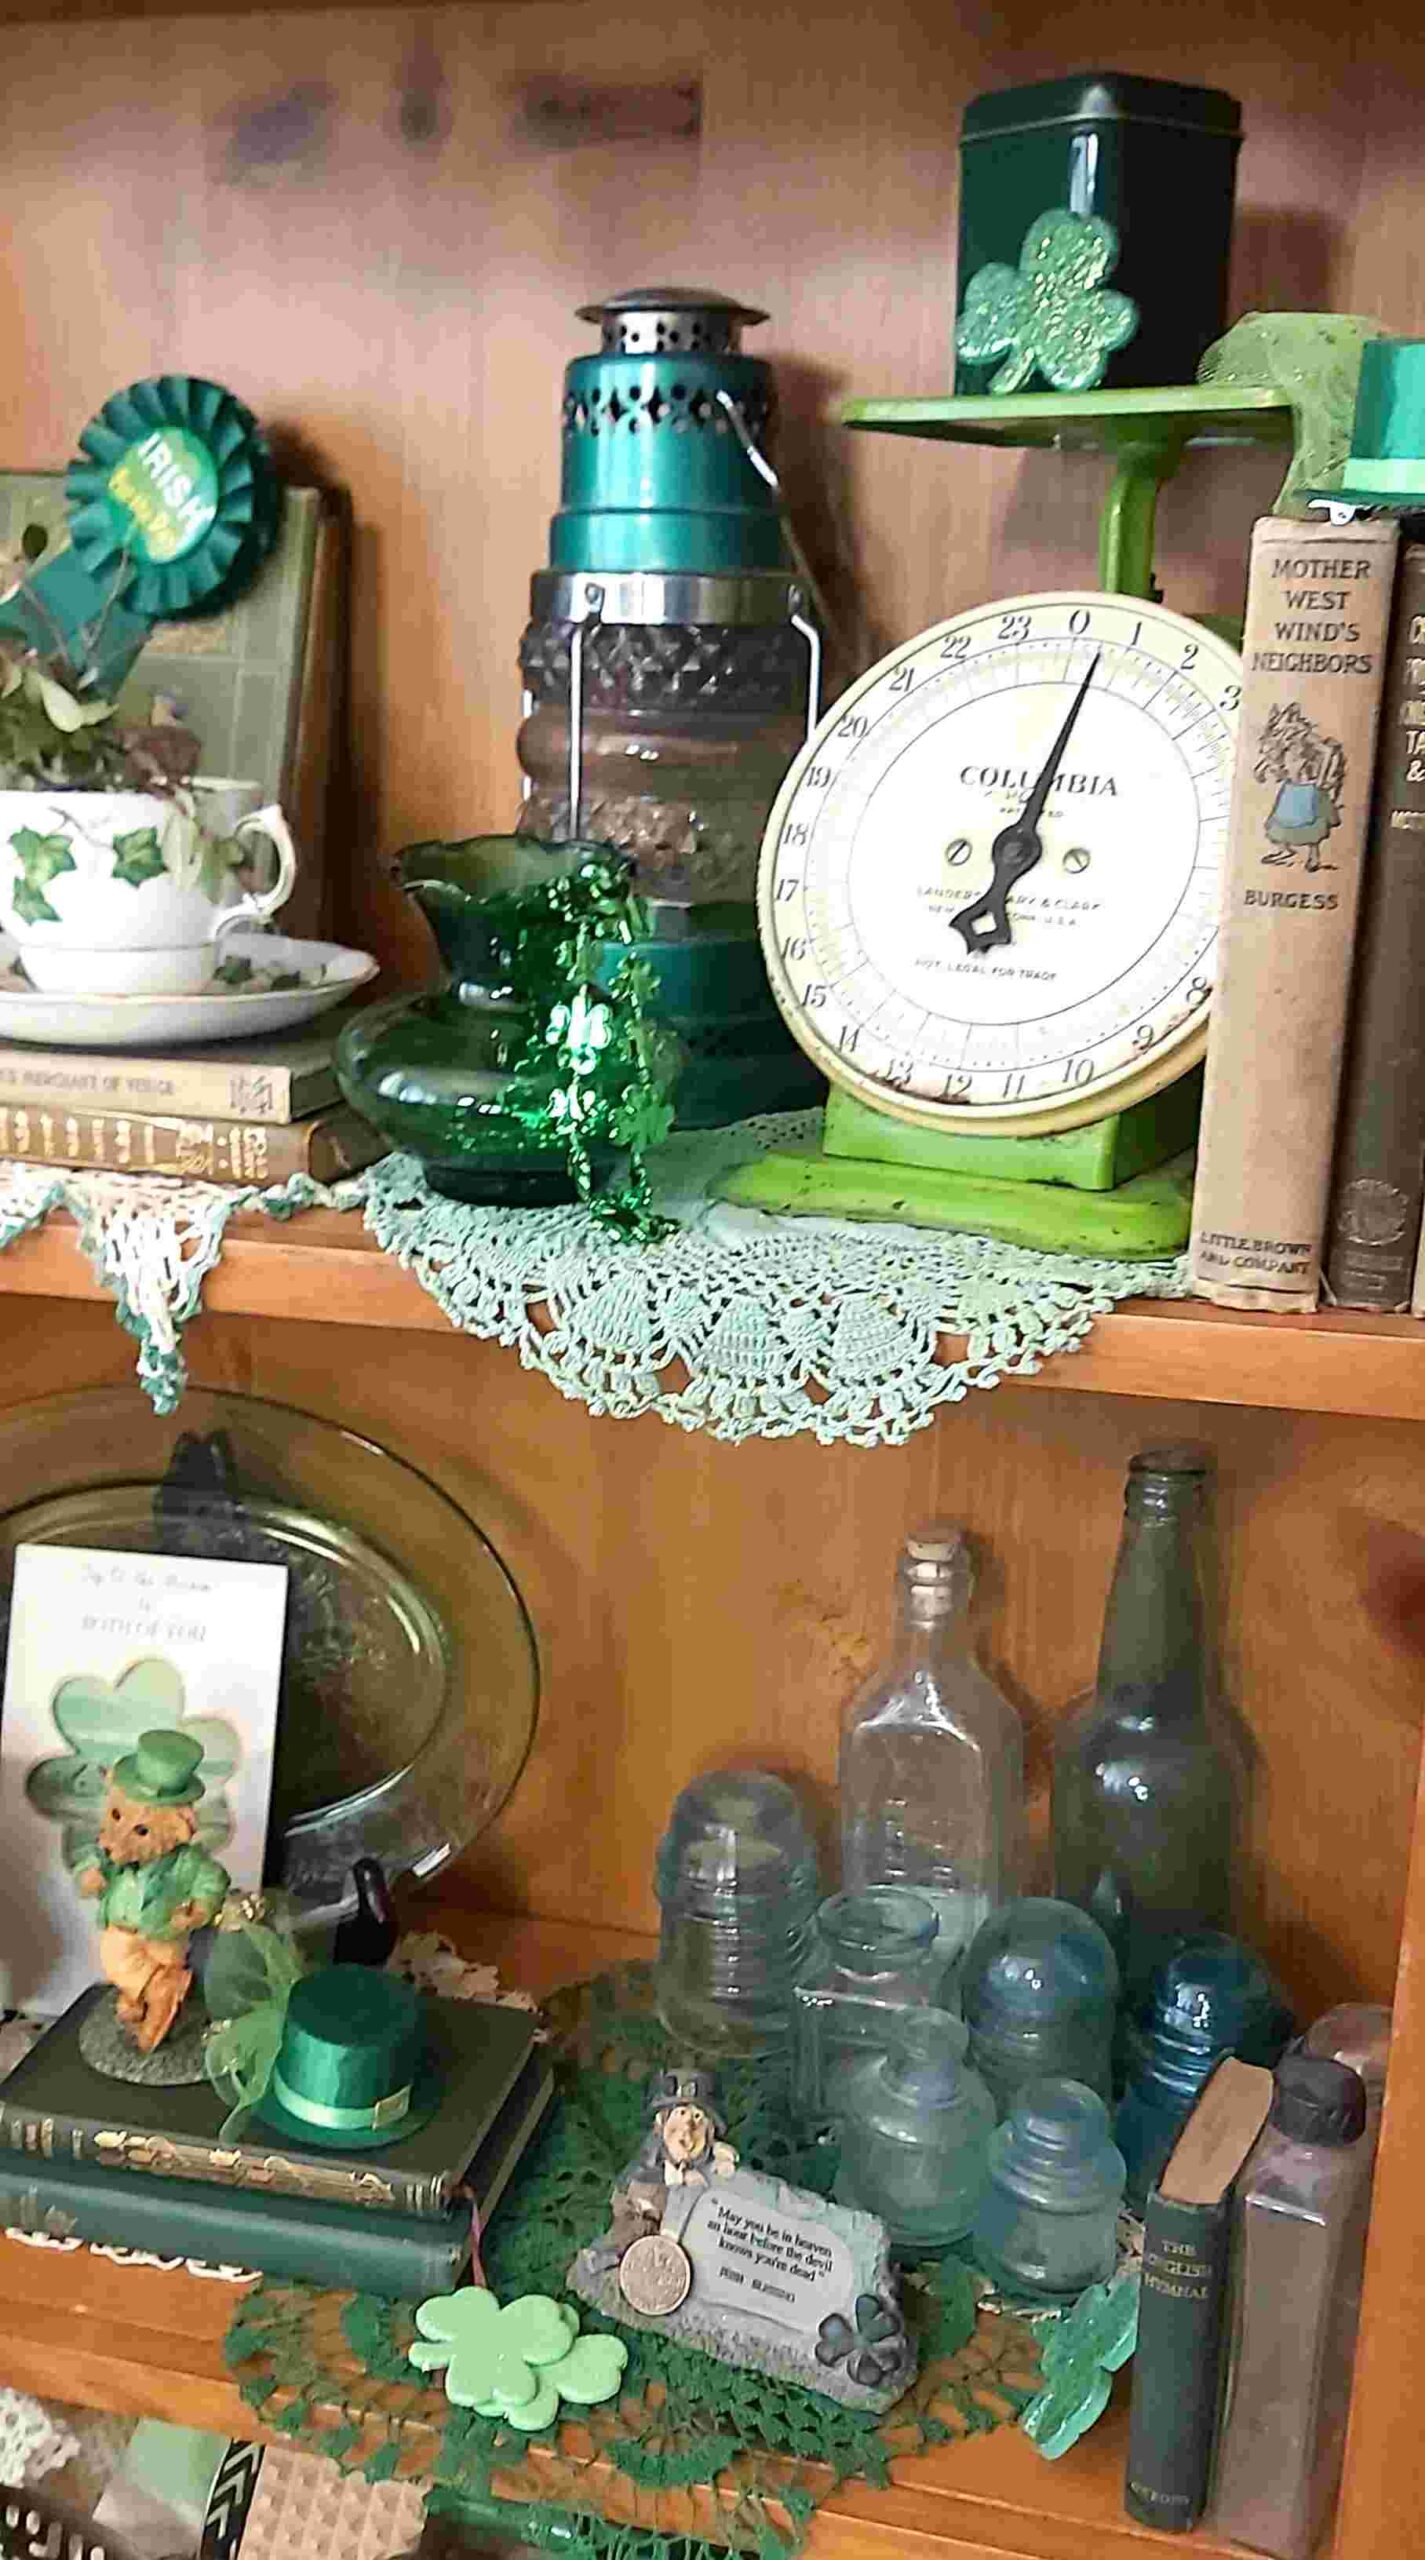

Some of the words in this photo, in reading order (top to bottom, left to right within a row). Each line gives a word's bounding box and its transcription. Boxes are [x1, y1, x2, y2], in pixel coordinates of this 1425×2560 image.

[138, 432, 217, 551] IRISH
[1271, 558, 1371, 580] MOTHER
[1284, 590, 1351, 610] WEST
[997, 613, 1032, 640] 23
[1069, 609, 1091, 635] 0
[1130, 621, 1143, 646] 1
[1274, 622, 1361, 642] WIND'S
[940, 635, 972, 660] 22
[1180, 643, 1200, 671] 2
[1251, 652, 1374, 674] NEIGHBORS
[889, 666, 915, 693] 21
[1219, 684, 1242, 712] 3
[837, 714, 869, 739] 20
[806, 766, 832, 788] 19
[782, 822, 810, 848] 18
[776, 878, 801, 902] 17
[1243, 890, 1339, 910] BURGESS
[780, 936, 807, 961] 16
[801, 984, 827, 1009] 15
[1186, 976, 1211, 1005] 8
[834, 1025, 860, 1054] 14
[1132, 1025, 1154, 1052] 9
[1062, 1058, 1096, 1084] 10
[941, 1073, 974, 1100] 12
[1001, 1072, 1027, 1099] 11
[1233, 1256, 1311, 1275] COMPANY
[707, 2220, 722, 2232] an
[723, 2220, 748, 2240] hour
[750, 2232, 784, 2254] before
[786, 2247, 803, 2261] the
[805, 2253, 833, 2273] devil
[718, 2235, 753, 2259] knows
[743, 2218, 765, 2233] you
[766, 2222, 780, 2239] be
[781, 2229, 793, 2243] in
[795, 2233, 832, 2258] heaven
[1161, 2240, 1197, 2257] THE
[1144, 2273, 1209, 2299] HYMNAL
